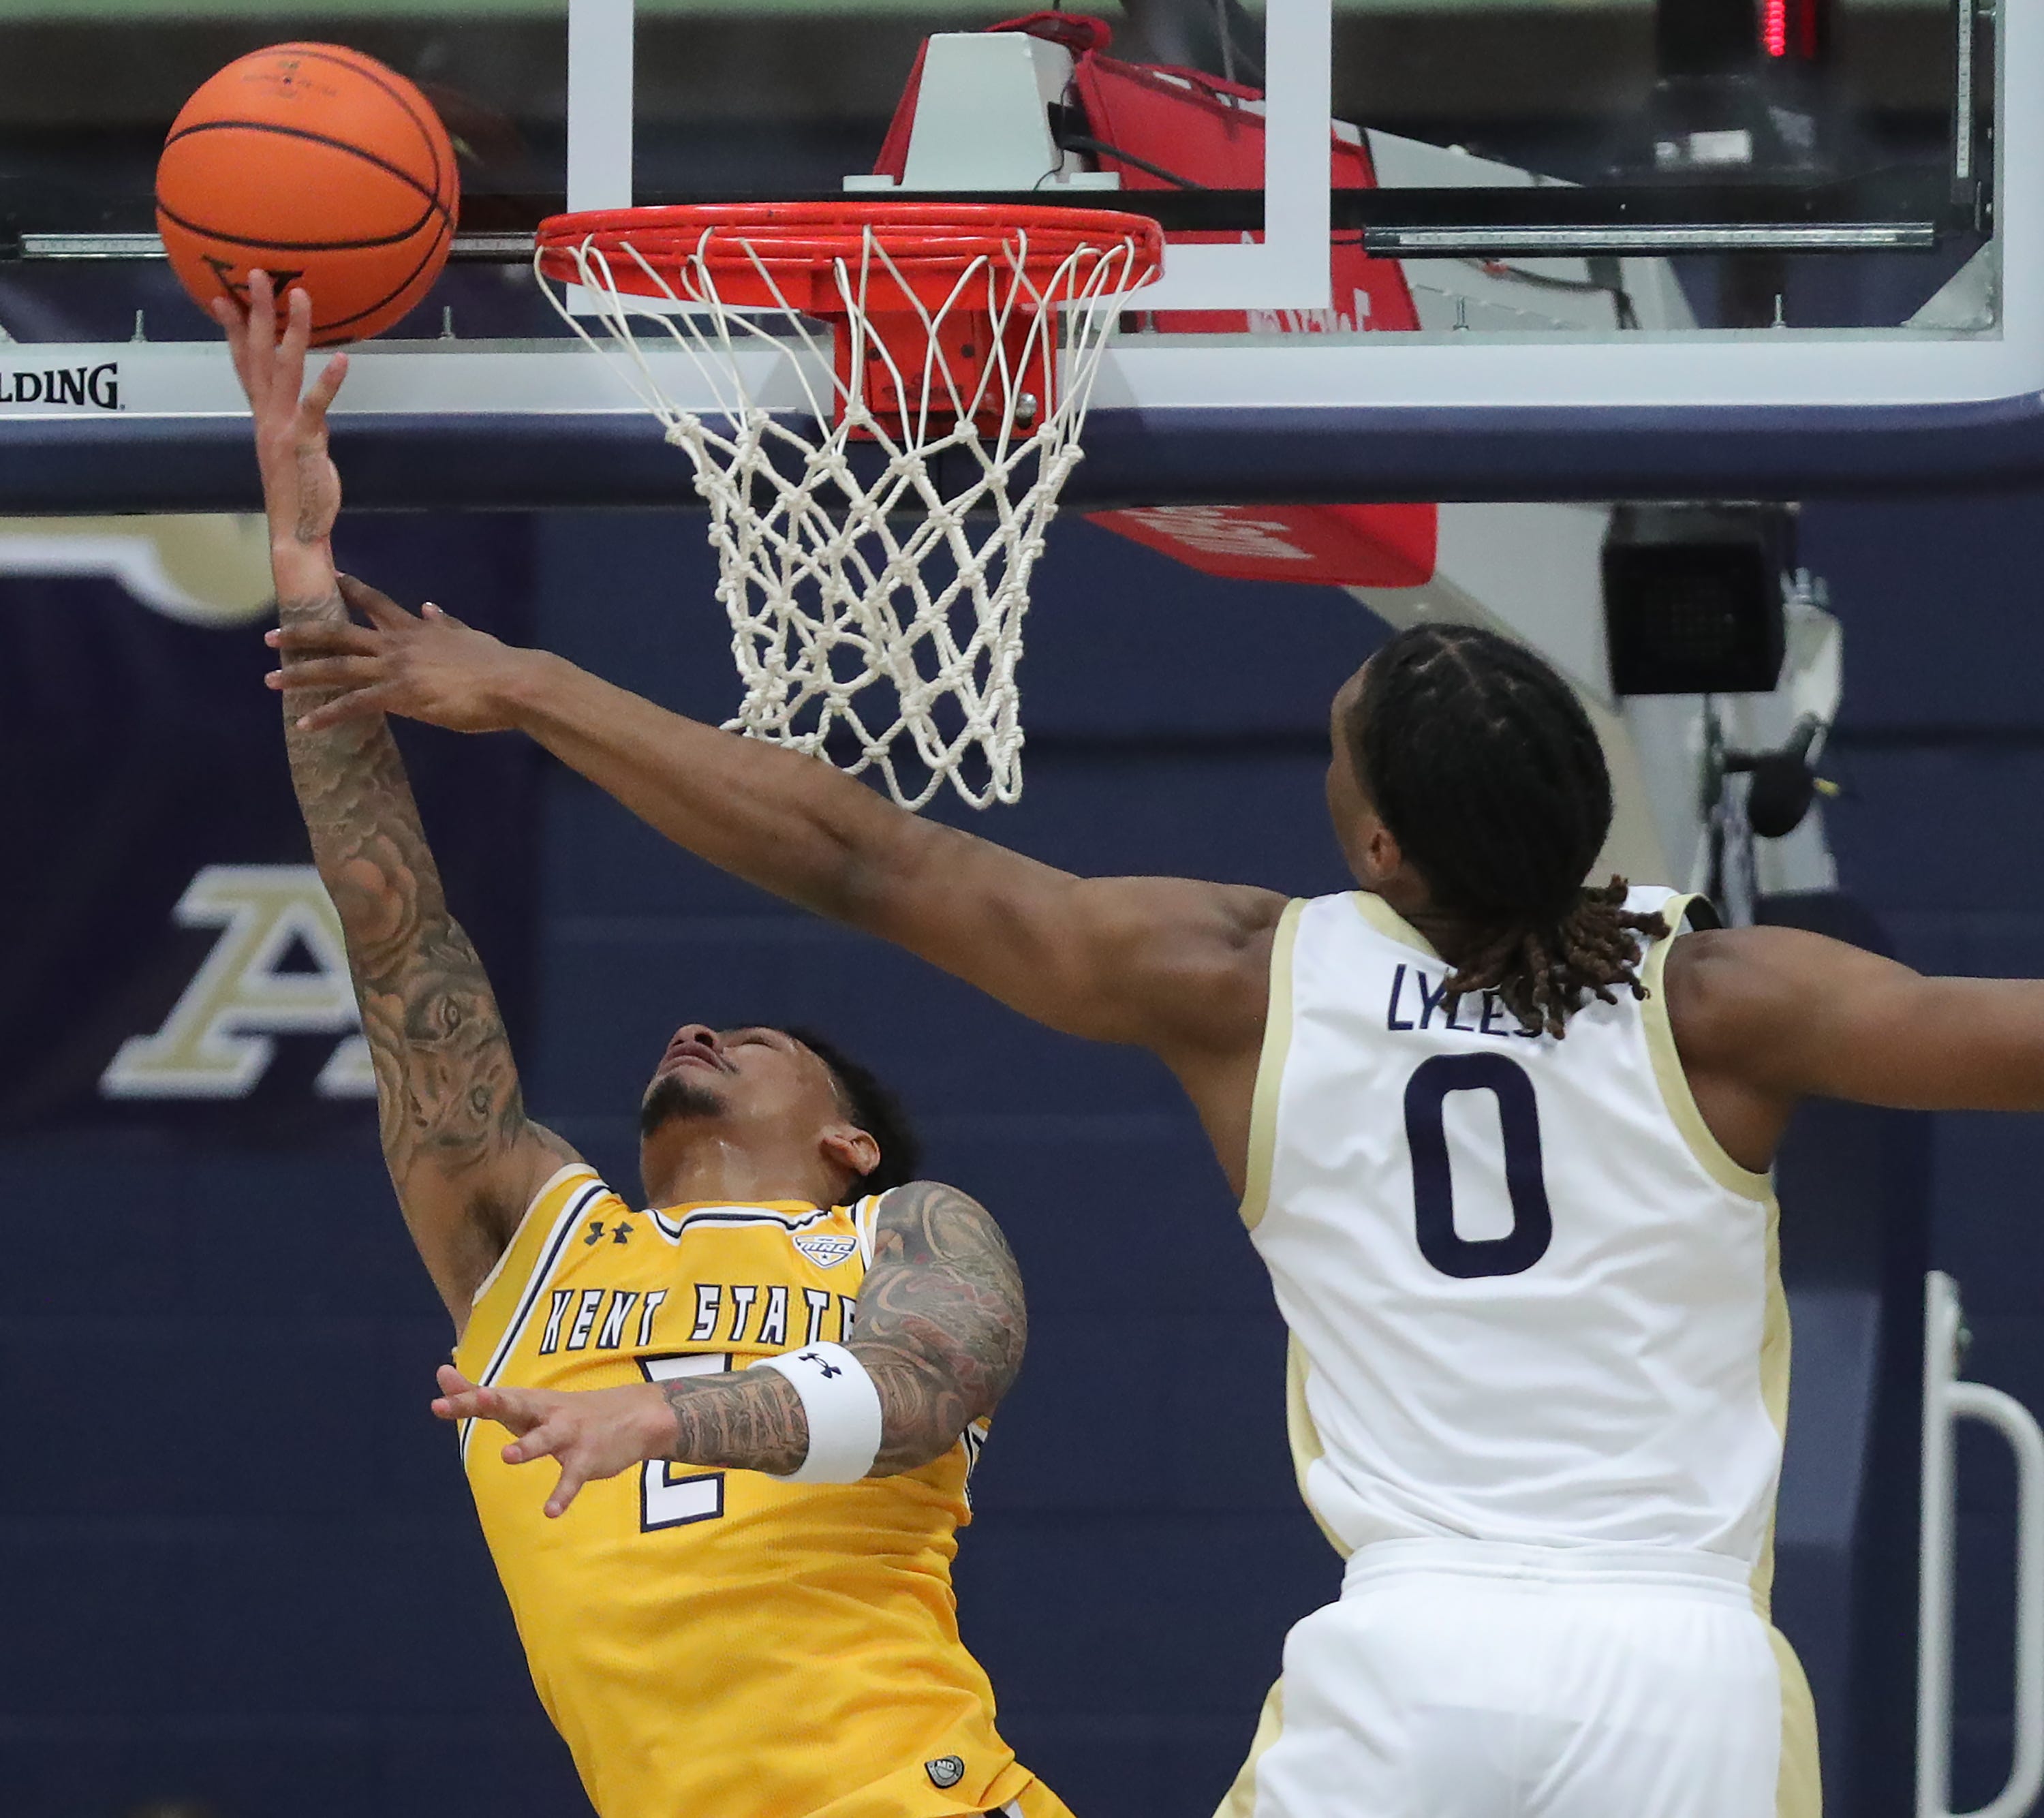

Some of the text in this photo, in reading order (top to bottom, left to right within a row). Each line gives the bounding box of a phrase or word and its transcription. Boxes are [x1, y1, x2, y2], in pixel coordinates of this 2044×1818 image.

[1388, 964, 1543, 1038] LYLE
[1404, 1051, 1553, 1279] 0
[801, 1243, 853, 1254] MAC
[538, 1287, 670, 1356] KENT
